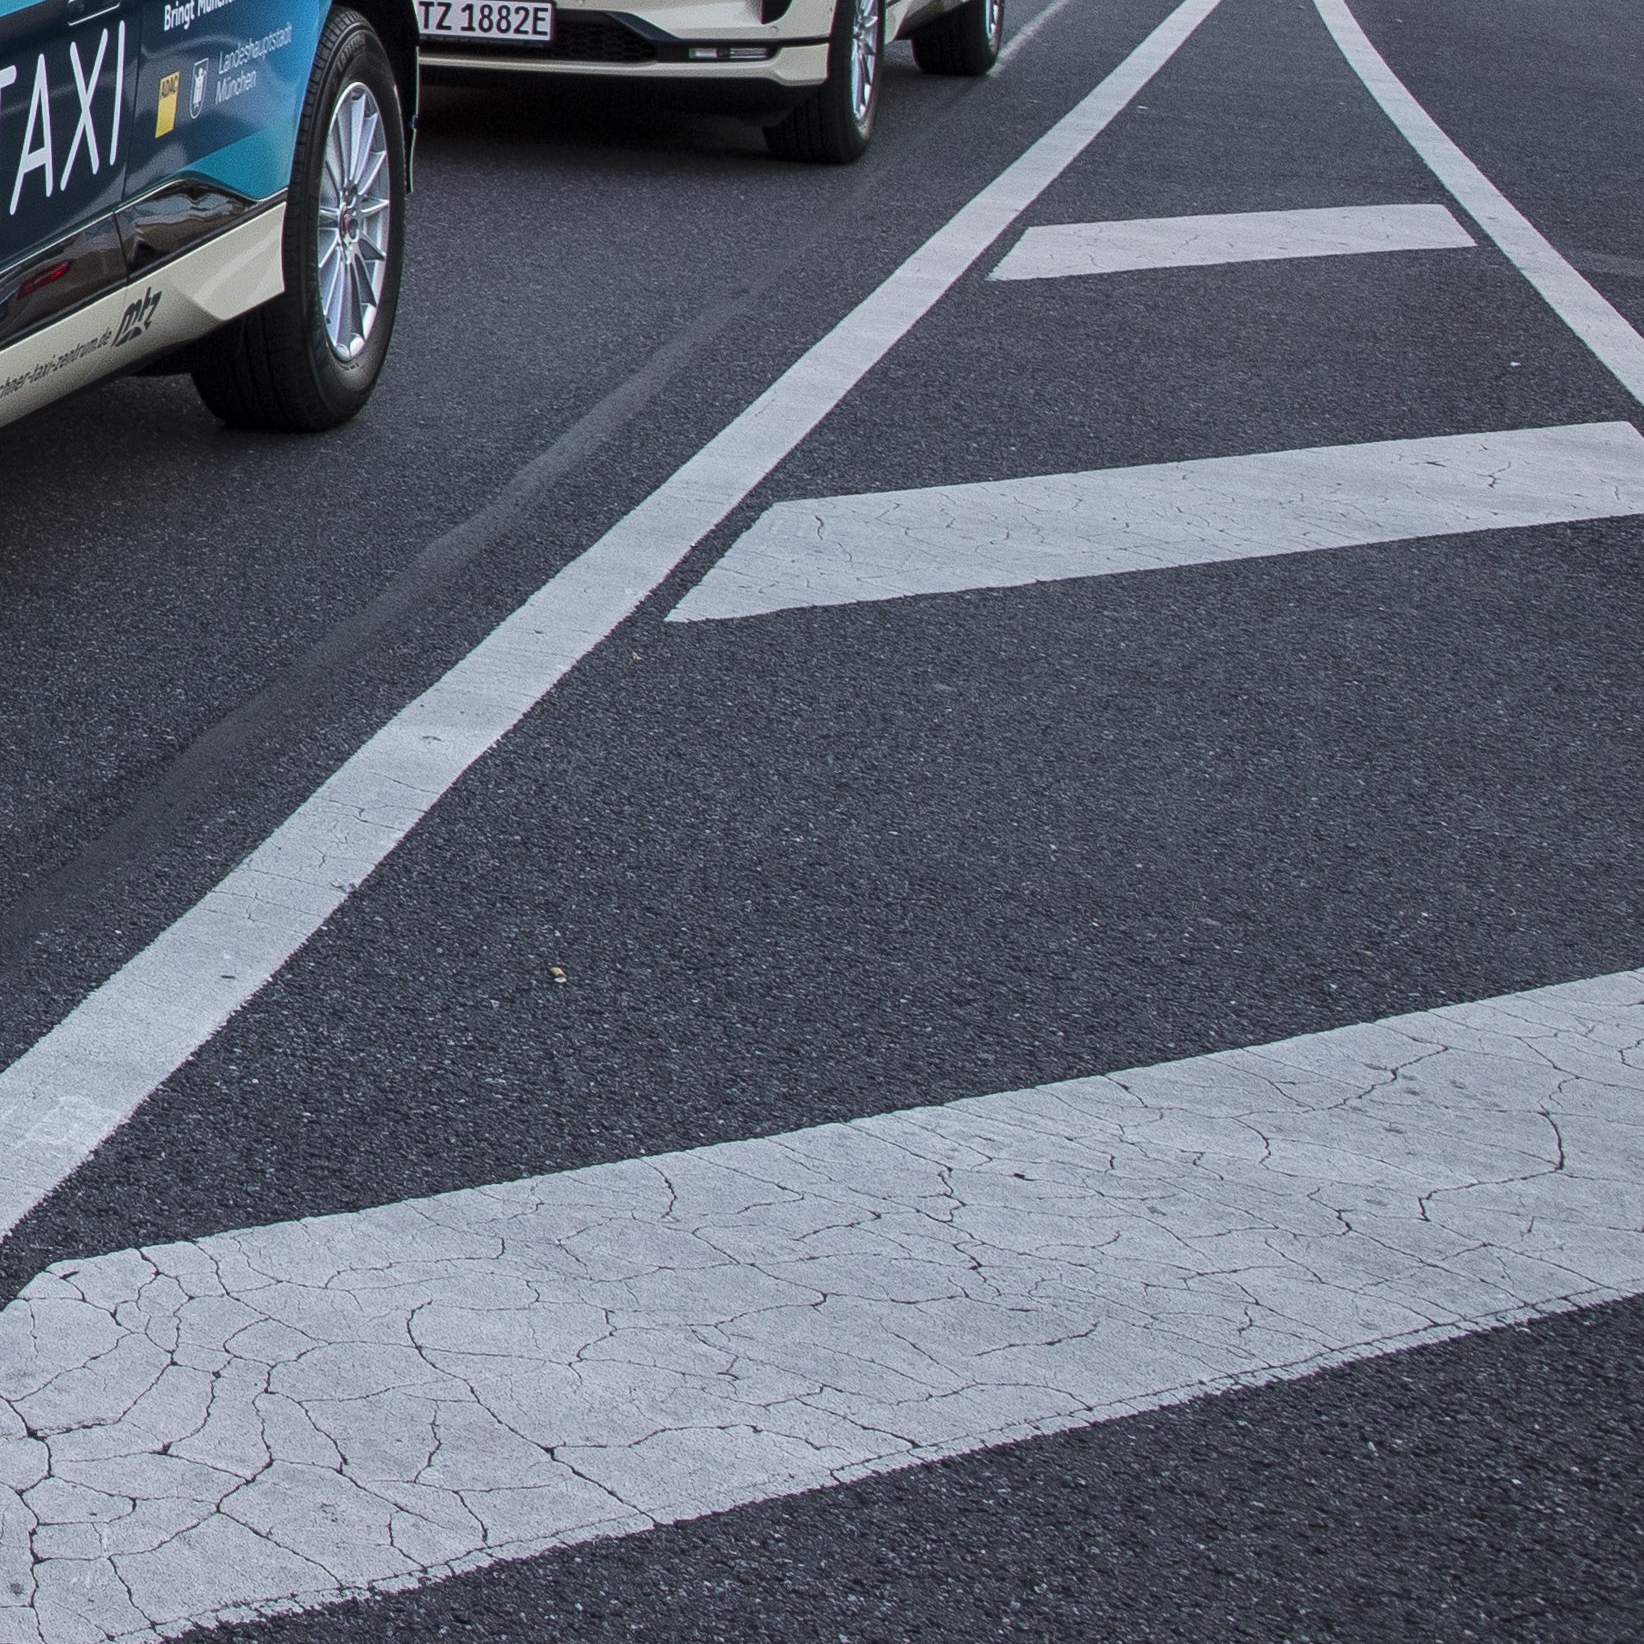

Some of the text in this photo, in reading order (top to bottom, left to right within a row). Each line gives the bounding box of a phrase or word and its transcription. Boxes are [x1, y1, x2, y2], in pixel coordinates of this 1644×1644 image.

[419, 1, 549, 36] TZ 1882E
[218, 21, 293, 75] Landeshauptstadt
[215, 70, 258, 105] München
